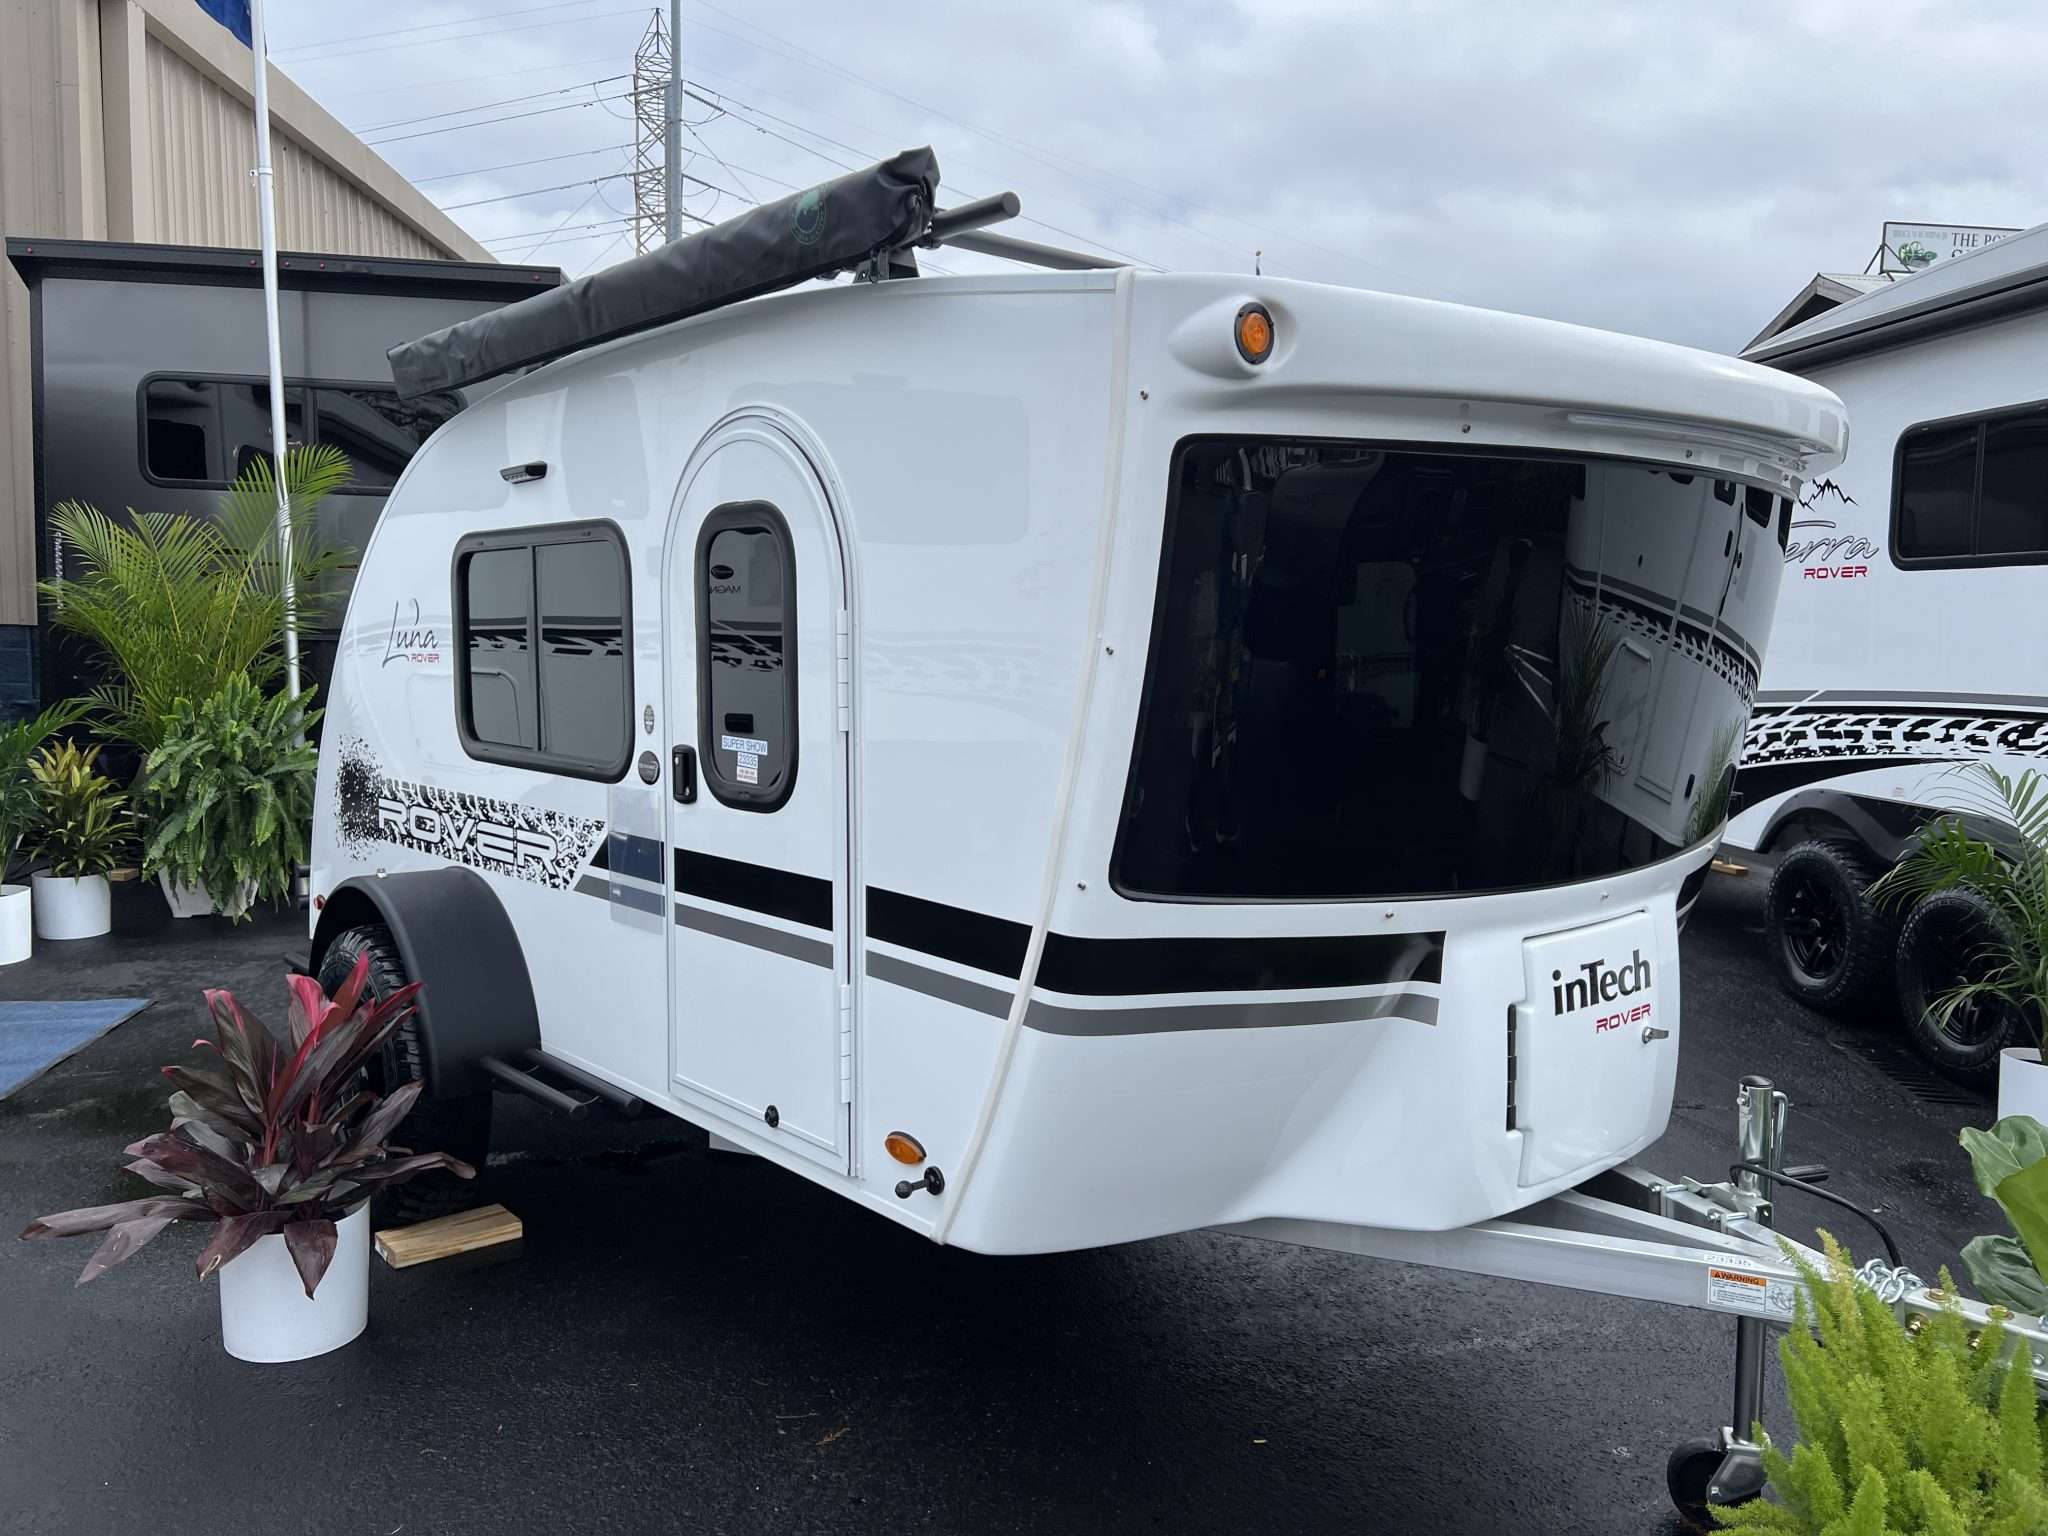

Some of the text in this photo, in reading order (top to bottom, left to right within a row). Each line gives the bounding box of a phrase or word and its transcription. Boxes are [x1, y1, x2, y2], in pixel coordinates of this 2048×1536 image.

[1952, 231, 1979, 248] THE
[1804, 565, 1868, 580] ROVER
[382, 599, 440, 669] Luna
[410, 653, 440, 664] ROVER
[723, 736, 767, 753] SUPER SHOW
[378, 797, 560, 876] ROVER
[1552, 948, 1652, 1016] inTech
[1595, 1003, 1652, 1034] ROVER
[1721, 1272, 1760, 1286] WARNING
